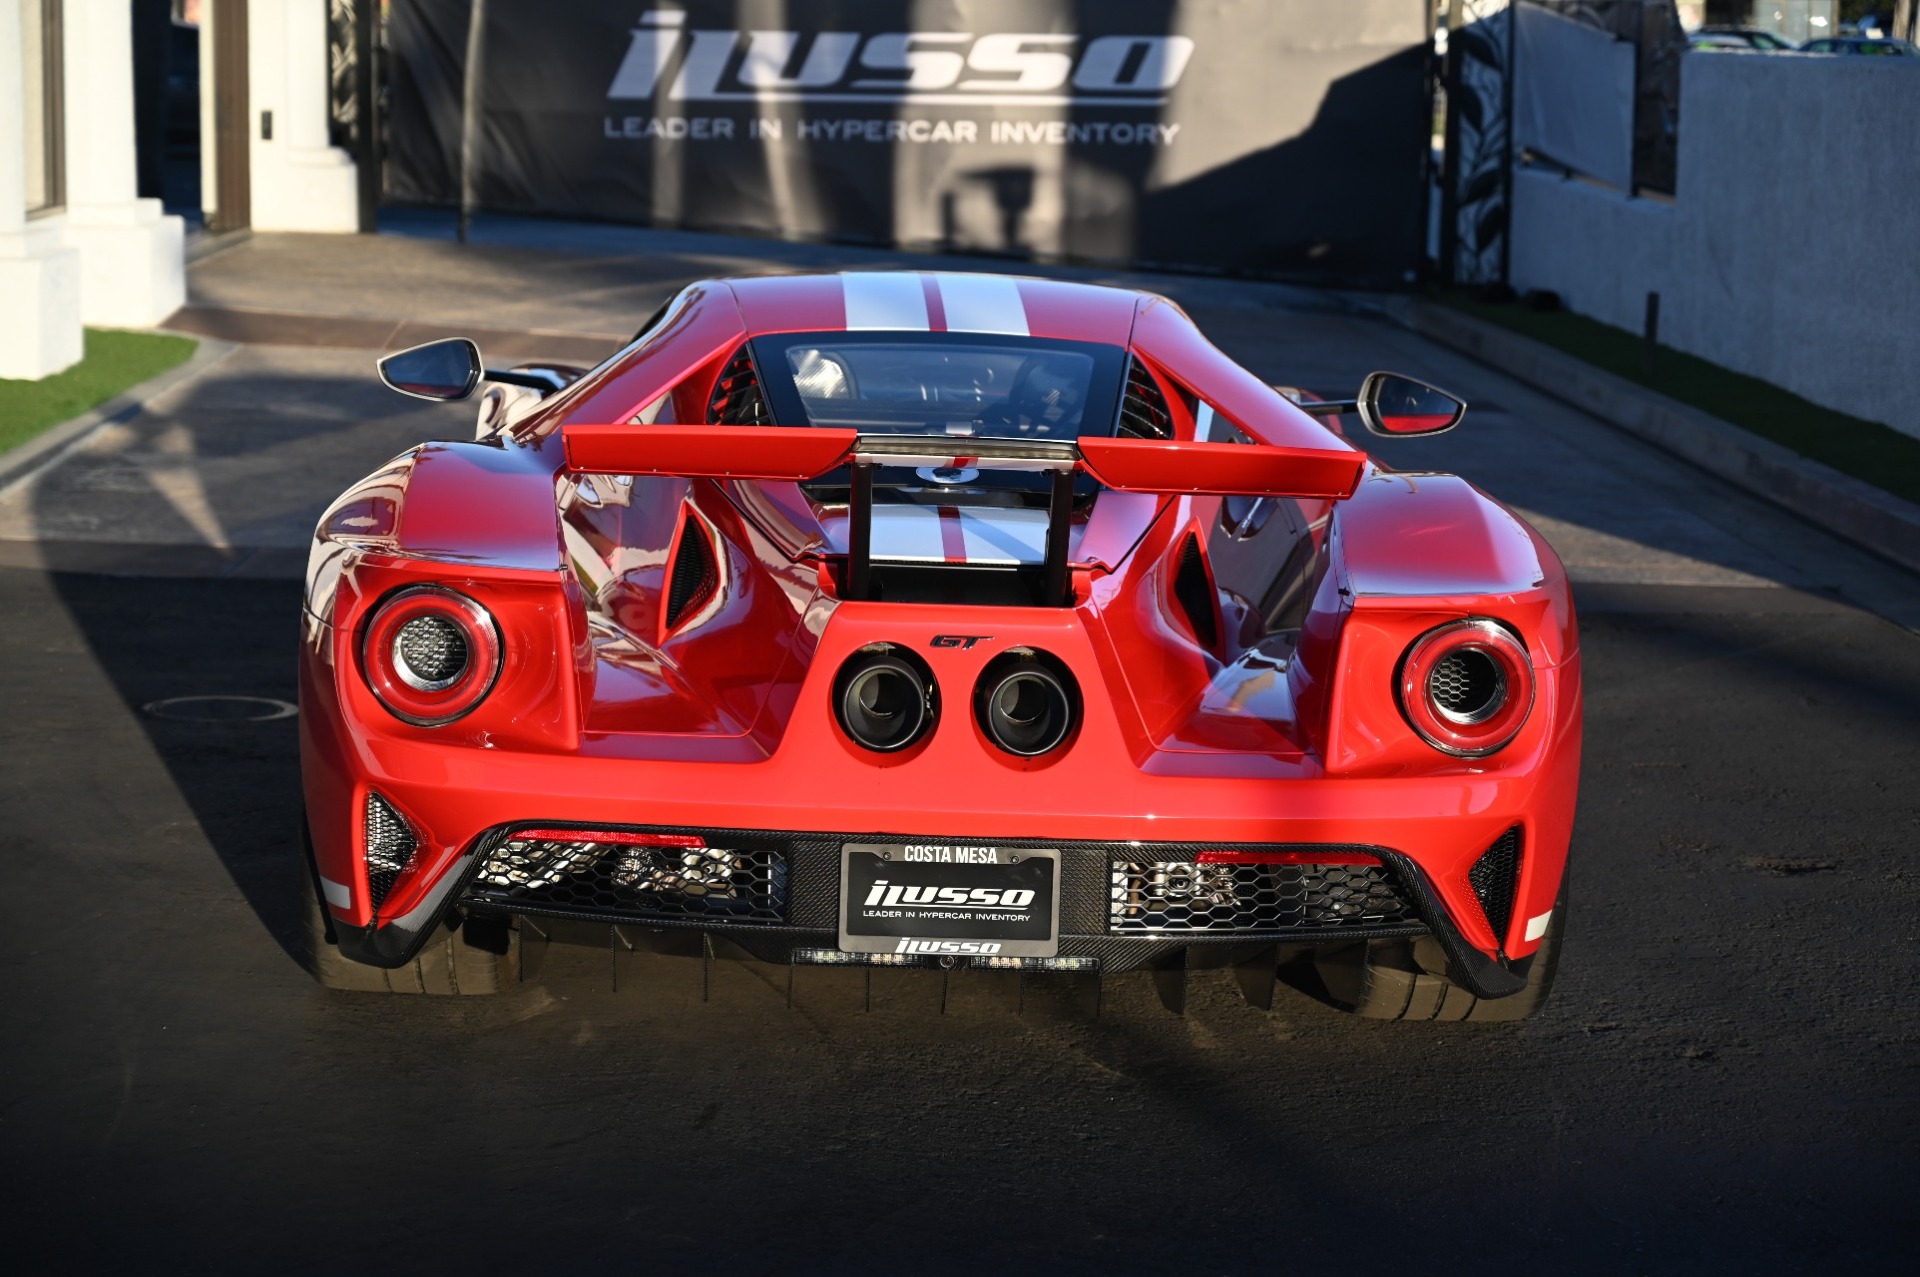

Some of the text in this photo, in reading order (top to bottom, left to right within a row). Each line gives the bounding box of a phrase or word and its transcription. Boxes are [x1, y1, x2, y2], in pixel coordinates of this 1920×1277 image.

[604, 116, 1181, 145] LEADER IN HYPERCAR INVENTORY
[930, 634, 995, 650] GT
[904, 845, 998, 864] COSTA MESA
[863, 910, 902, 918] LEADER
[919, 911, 971, 920] HYPERCAR
[975, 913, 1031, 922] INVENTORY
